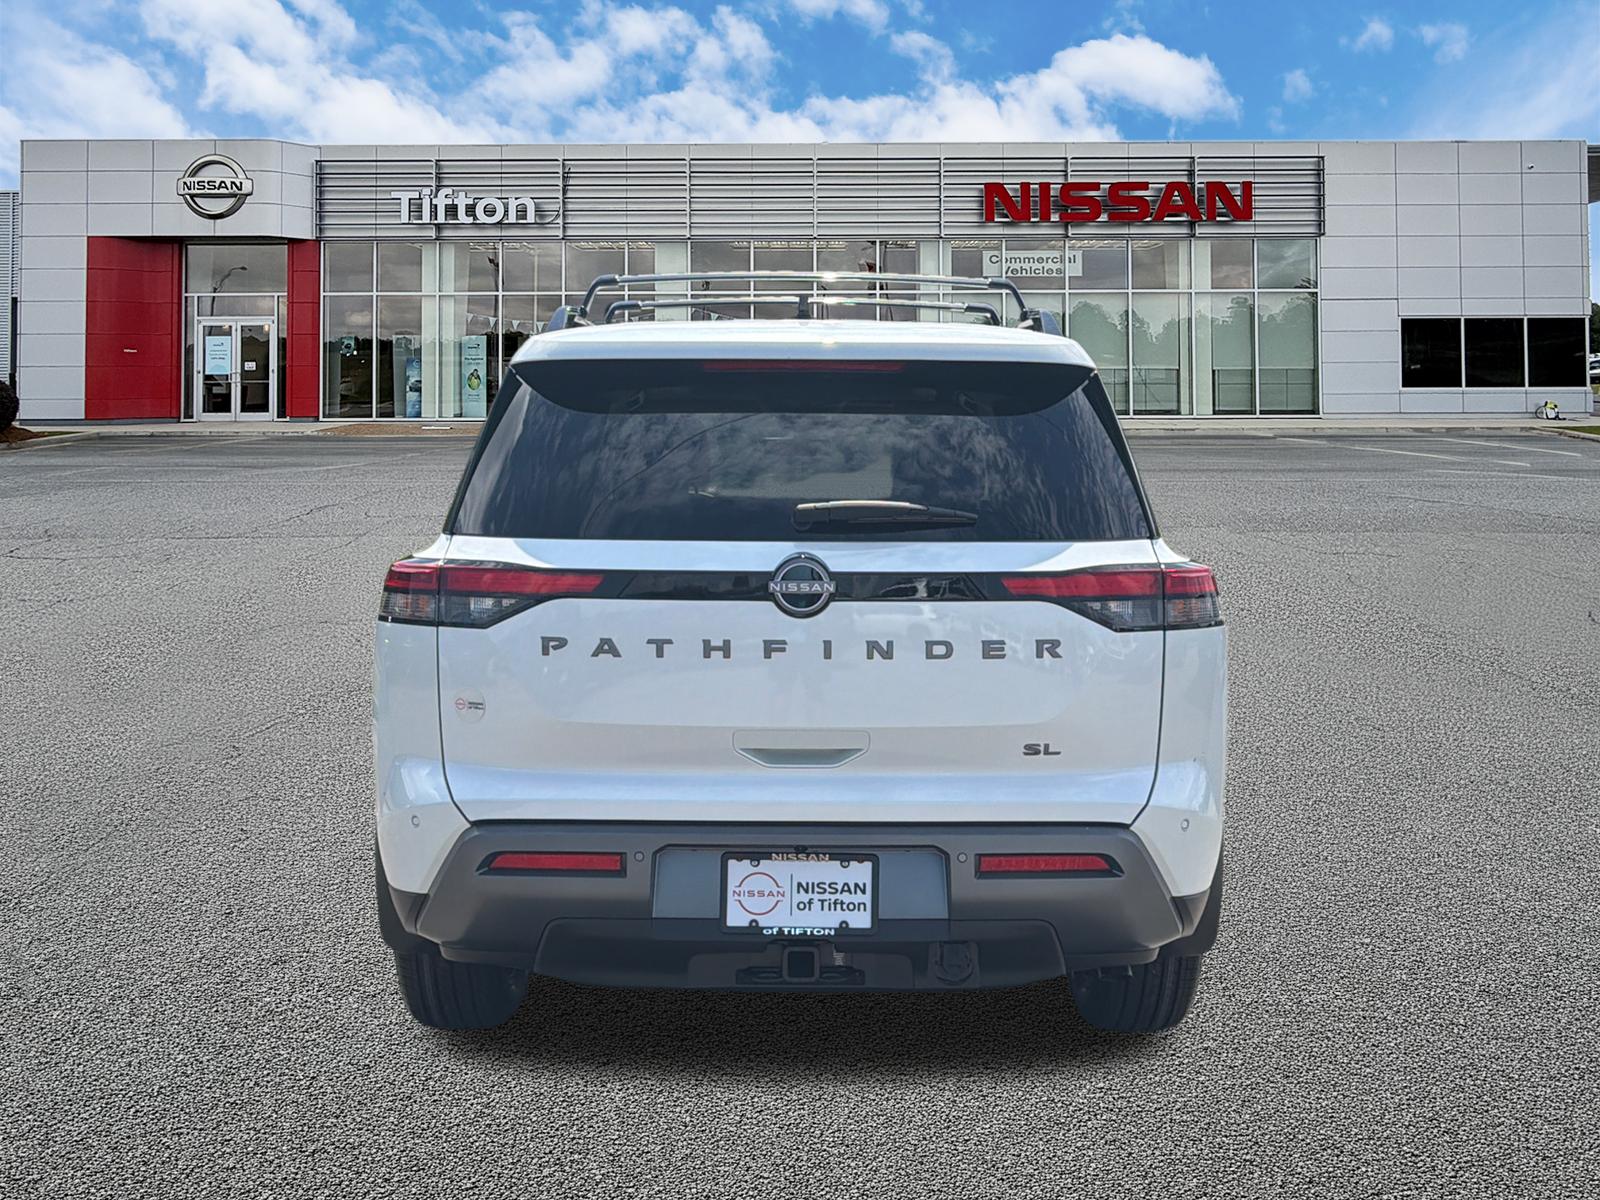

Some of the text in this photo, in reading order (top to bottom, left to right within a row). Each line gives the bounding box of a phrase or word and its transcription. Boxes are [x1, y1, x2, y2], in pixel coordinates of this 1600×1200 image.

[183, 181, 243, 191] NISSAN
[391, 188, 536, 224] Tifton
[984, 181, 1253, 222] NISSAN
[770, 583, 834, 592] NISSAN
[540, 636, 1063, 660] PATHFINDER
[1022, 743, 1061, 756] SL
[771, 853, 830, 861] NISSAN
[732, 889, 785, 898] NISSAN
[796, 882, 867, 895] NISSAN
[796, 898, 867, 912] of Tifton
[762, 927, 835, 936] of TIFTON
